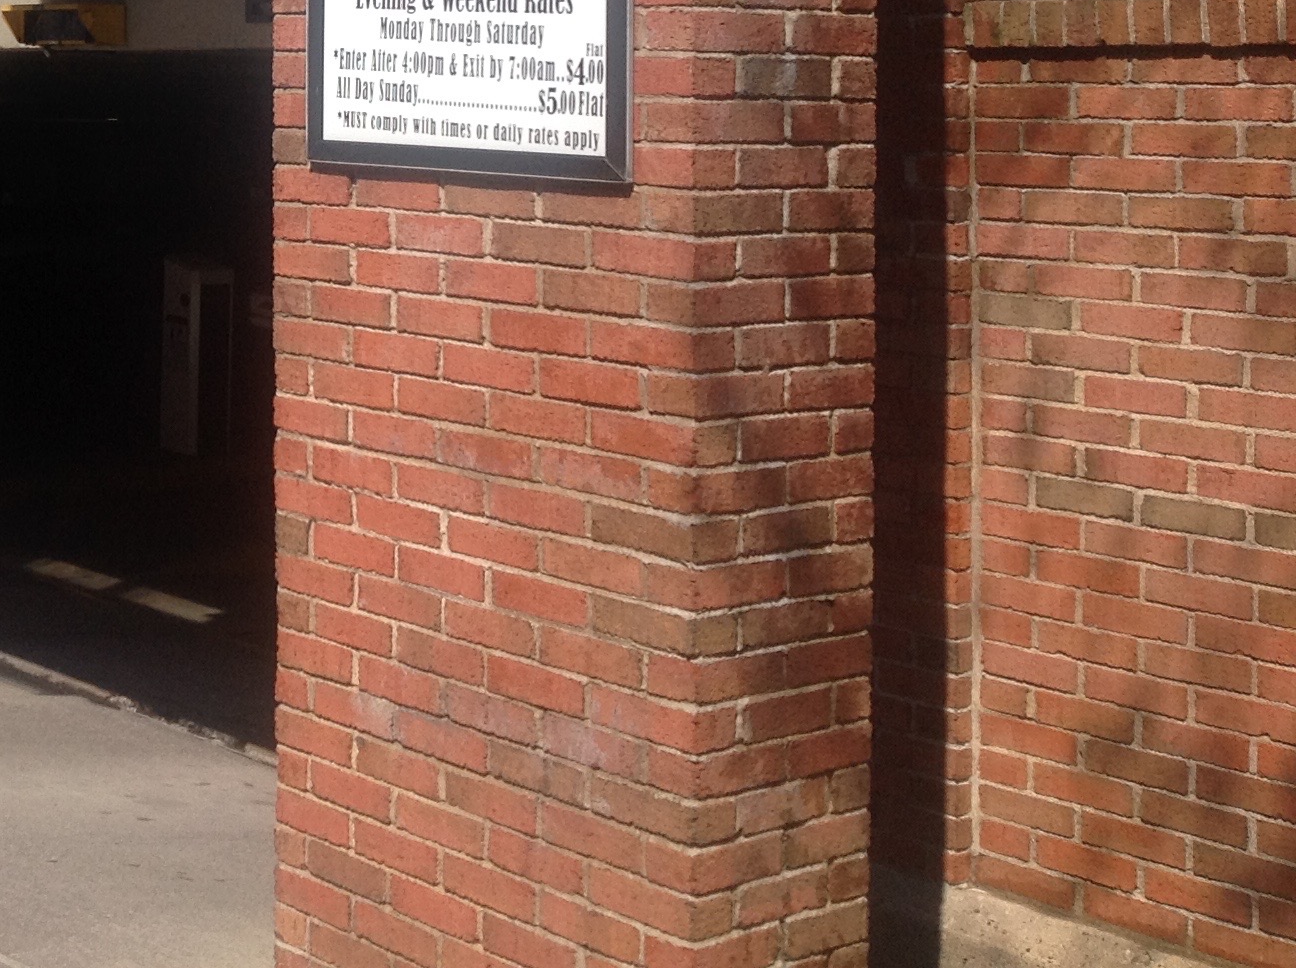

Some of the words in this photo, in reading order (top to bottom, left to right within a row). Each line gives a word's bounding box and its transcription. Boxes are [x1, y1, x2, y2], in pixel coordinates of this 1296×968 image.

[381, 17, 422, 43] Monday
[430, 18, 480, 46] Through
[487, 20, 543, 48] Saturday
[371, 49, 397, 73] After
[402, 51, 444, 77] 4:00pm
[449, 54, 459, 75] &
[463, 54, 484, 77] Exit
[490, 57, 502, 81] by
[587, 43, 603, 56] Flat
[337, 77, 350, 98] All
[355, 78, 374, 106] Day
[578, 91, 604, 117] Flat
[371, 115, 407, 133] comply
[413, 118, 436, 135] with
[442, 120, 470, 138] times
[476, 124, 488, 139] or
[493, 123, 522, 145] daily
[529, 128, 558, 145] rates
[564, 130, 598, 152] apply
